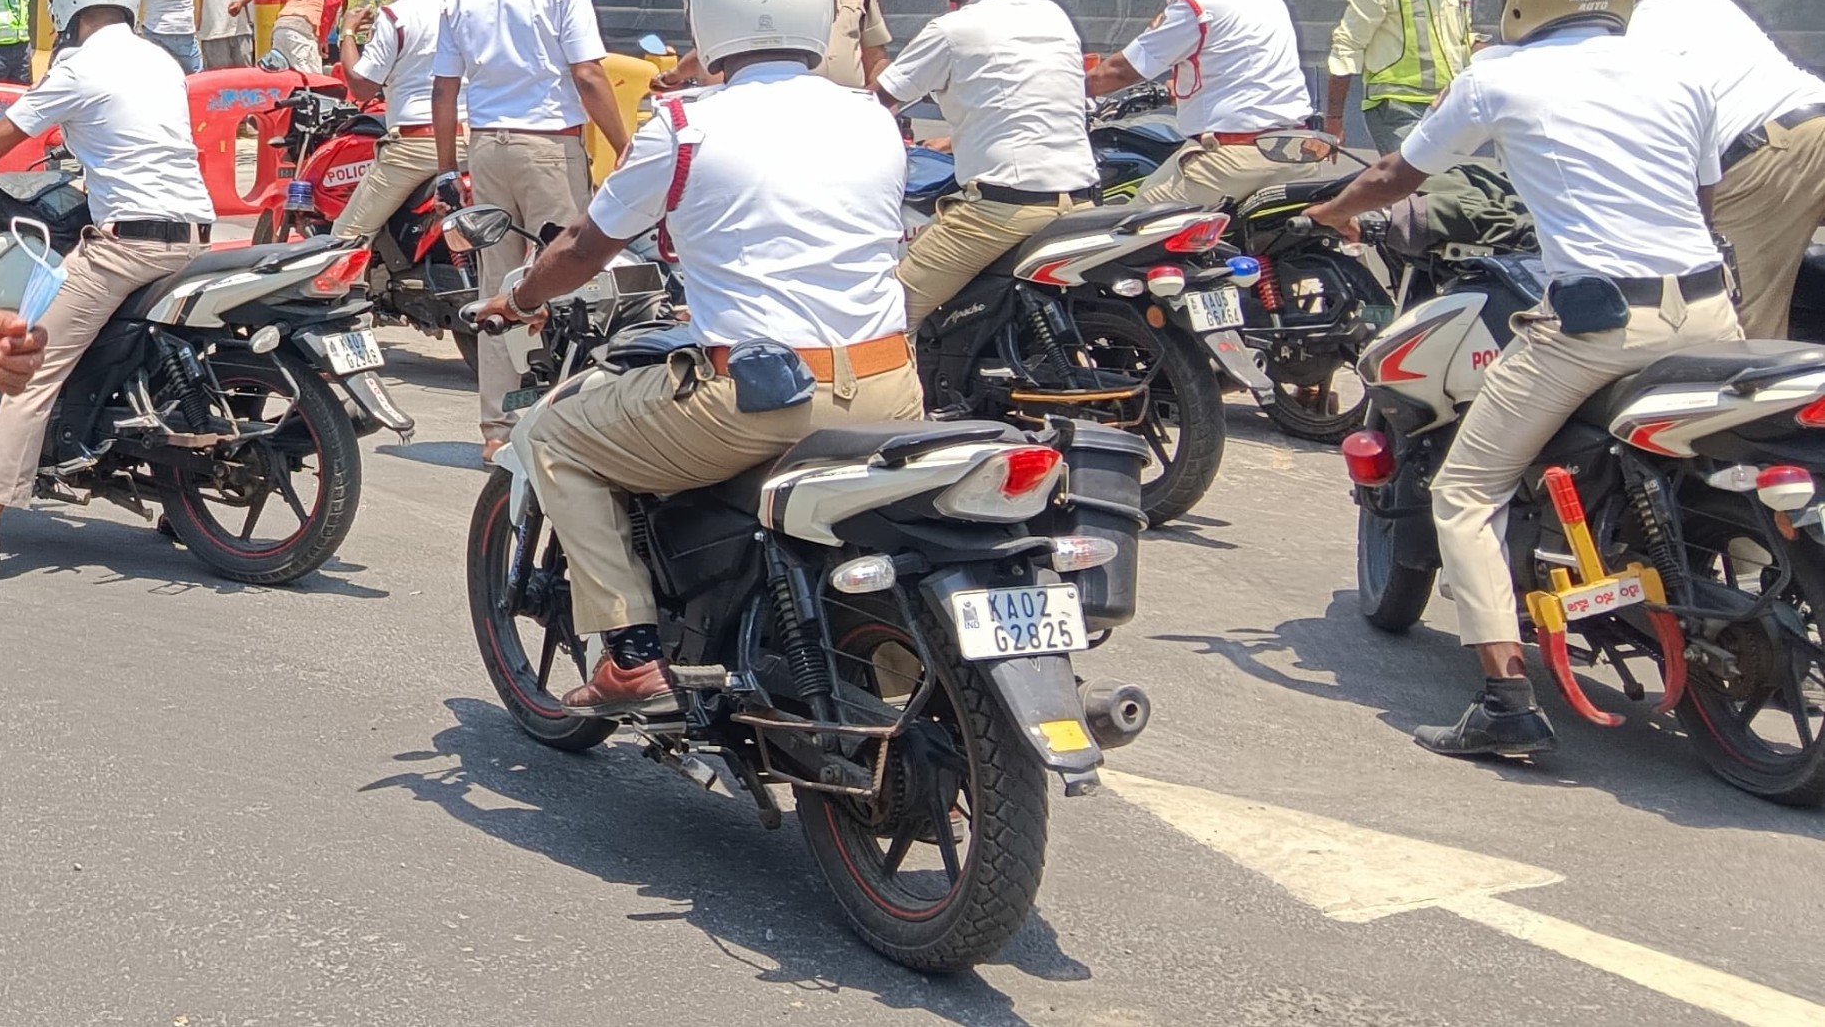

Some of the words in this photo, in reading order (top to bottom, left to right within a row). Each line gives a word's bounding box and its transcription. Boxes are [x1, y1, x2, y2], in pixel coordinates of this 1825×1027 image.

[1578, 1, 1609, 11] AUTO
[989, 591, 1052, 622] KA02
[965, 621, 980, 629] IND
[994, 619, 1073, 652] G2825
